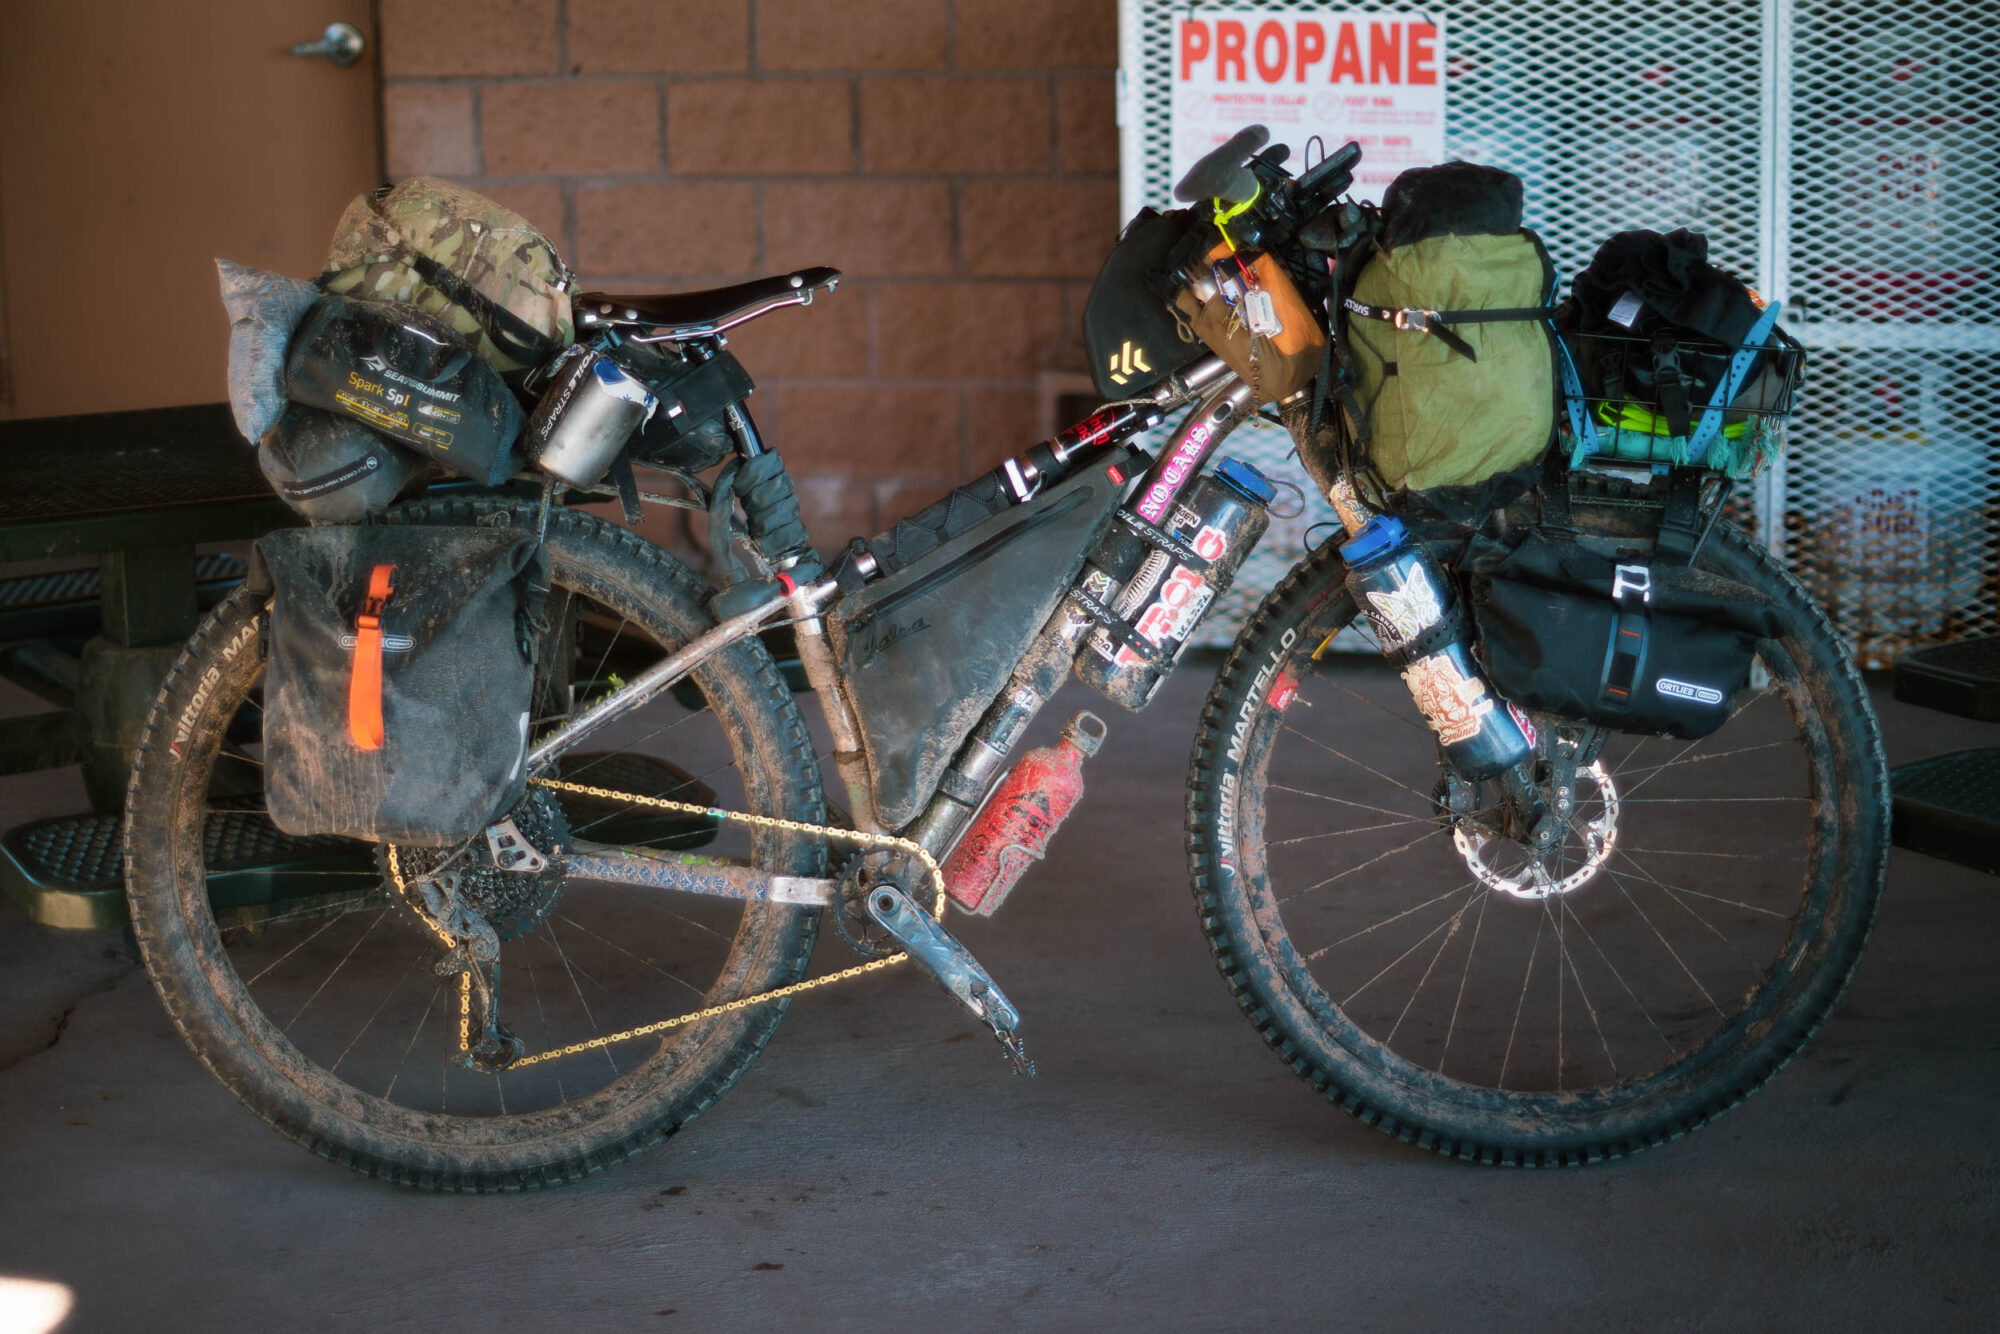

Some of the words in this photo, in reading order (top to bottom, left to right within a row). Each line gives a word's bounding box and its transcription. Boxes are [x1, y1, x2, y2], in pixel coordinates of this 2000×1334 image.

[1180, 19, 1437, 85] PROPANE
[1344, 298, 1369, 316] SURLY
[348, 371, 384, 397] Spark
[541, 388, 571, 438] STRAPS
[1140, 484, 1169, 519] NO
[1163, 425, 1209, 485] CARS
[1116, 509, 1147, 530] OILE
[1143, 528, 1191, 561] STRAPS
[1069, 589, 1112, 625] STRAPS
[1226, 627, 1297, 762] MARTELLO
[1660, 681, 1695, 696] ORTLIEB
